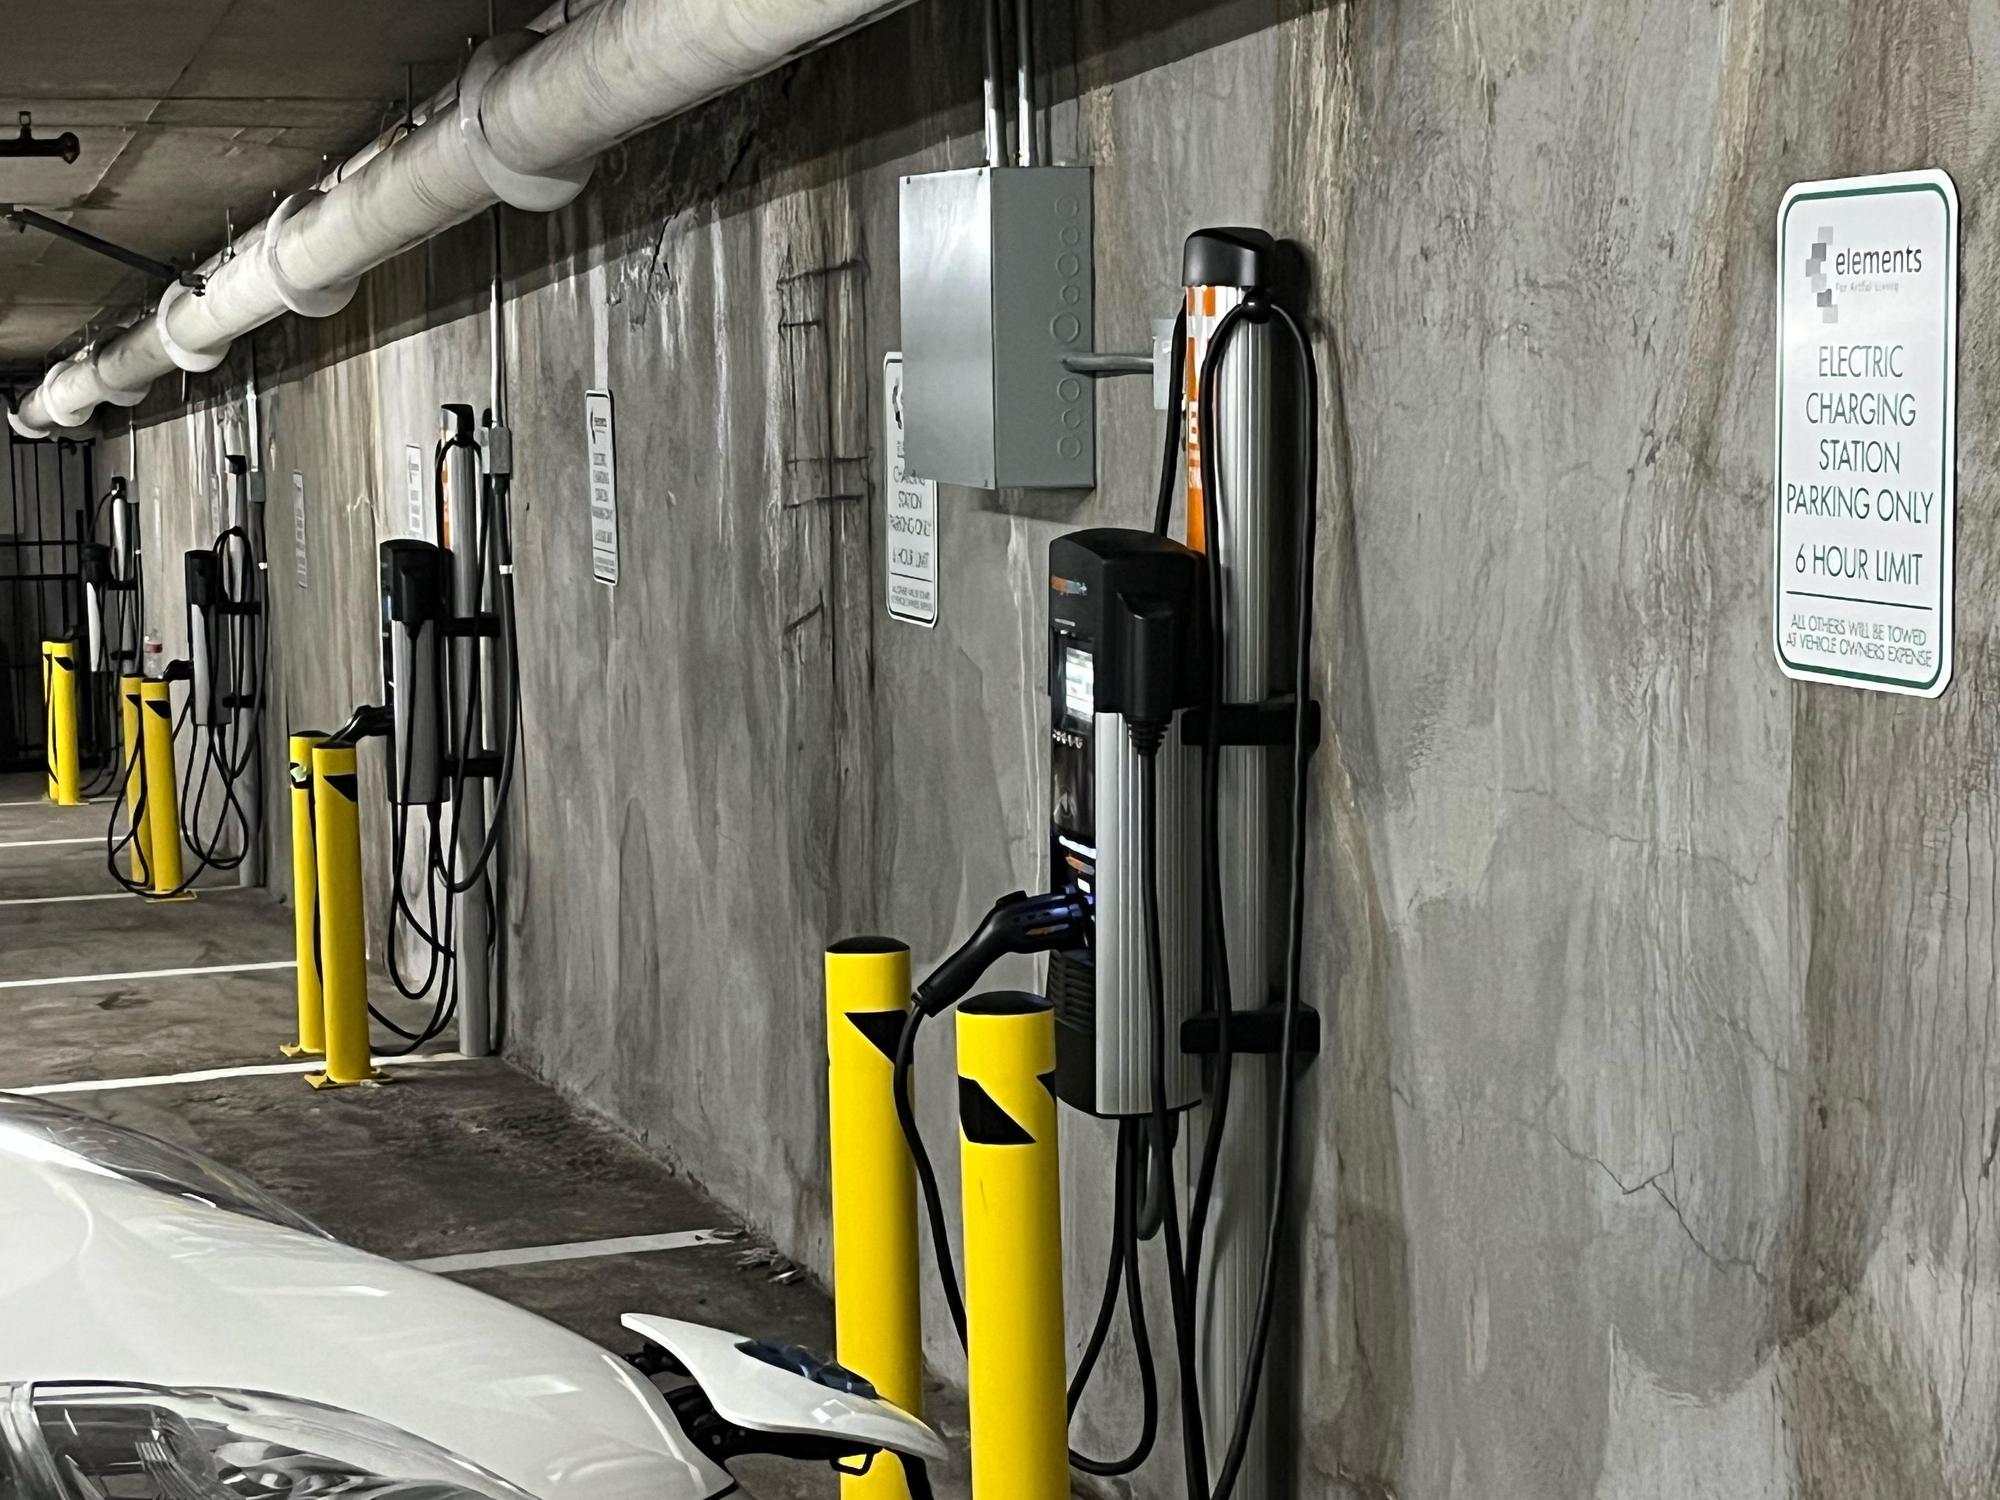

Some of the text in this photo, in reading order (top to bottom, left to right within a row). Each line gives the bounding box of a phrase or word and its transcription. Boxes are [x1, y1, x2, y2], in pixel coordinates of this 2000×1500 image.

[1835, 245, 1922, 275] elements
[1818, 345, 1904, 378] ELECTRIC
[1806, 392, 1916, 427] CHARGING
[1819, 439, 1900, 474] STATION
[1786, 483, 1934, 524] PARKING ONLY
[1795, 544, 1923, 585] 6 HOUR LIMIT
[1786, 632, 1797, 647] AT
[1800, 633, 1836, 654] VEHICLE
[1791, 614, 1927, 646] ALL OTHERS WILL BE TOWED
